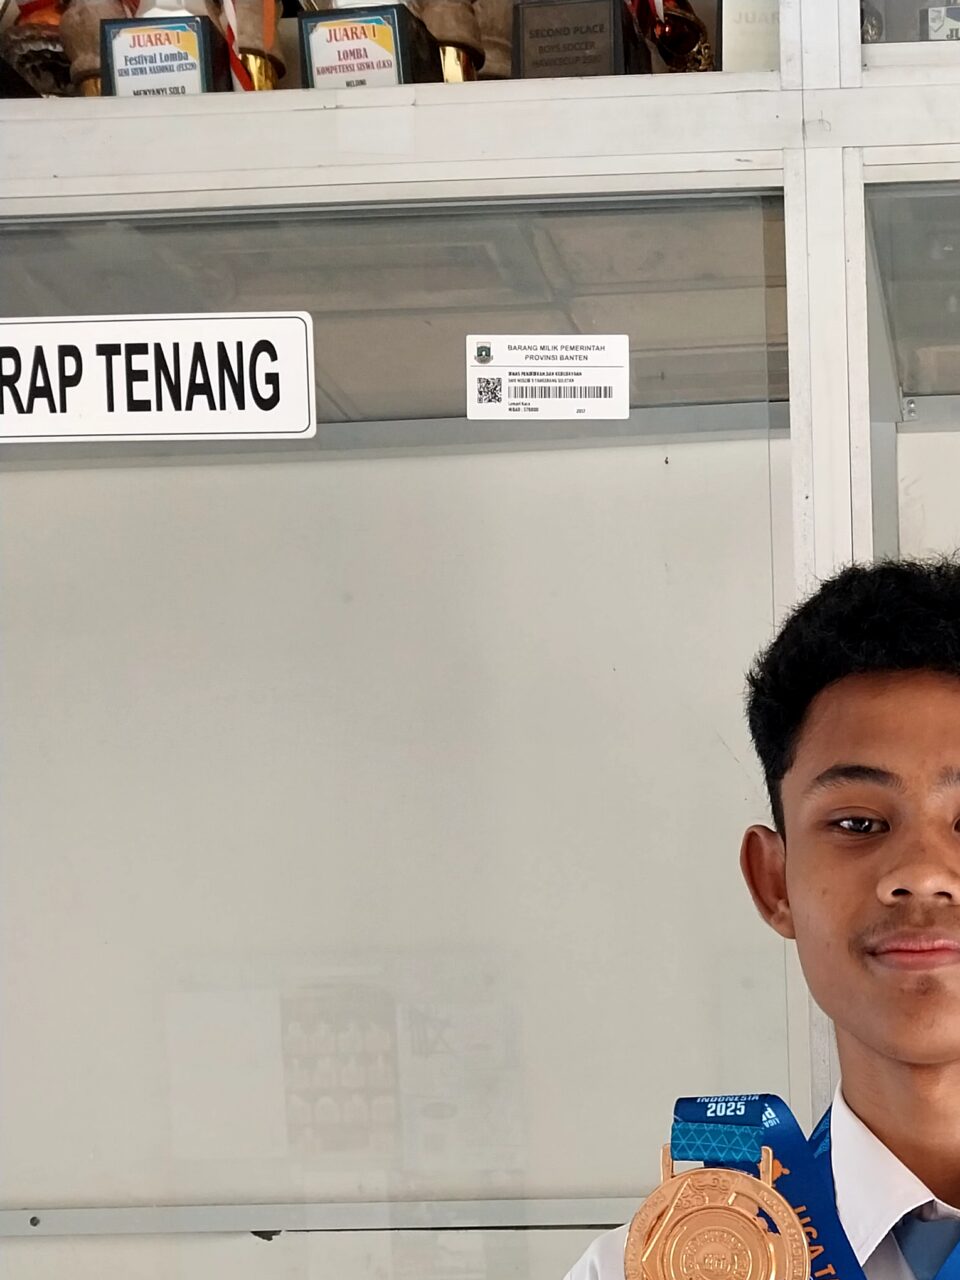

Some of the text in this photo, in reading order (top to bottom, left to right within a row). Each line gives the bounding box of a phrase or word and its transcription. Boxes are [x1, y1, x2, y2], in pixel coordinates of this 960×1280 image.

[326, 25, 368, 43] JUARA
[528, 24, 605, 39] SECOND PLACE
[129, 32, 172, 48] JUARA
[124, 51, 189, 67] Festival Lomba
[337, 48, 369, 61] LOMBA
[148, 64, 175, 74] NASIONAL
[316, 60, 393, 76] KOMPETENSI SISWA (LKS)
[169, 86, 186, 95] SOLO
[0, 339, 280, 414] RAP TENANG
[706, 1102, 746, 1117] 2025
